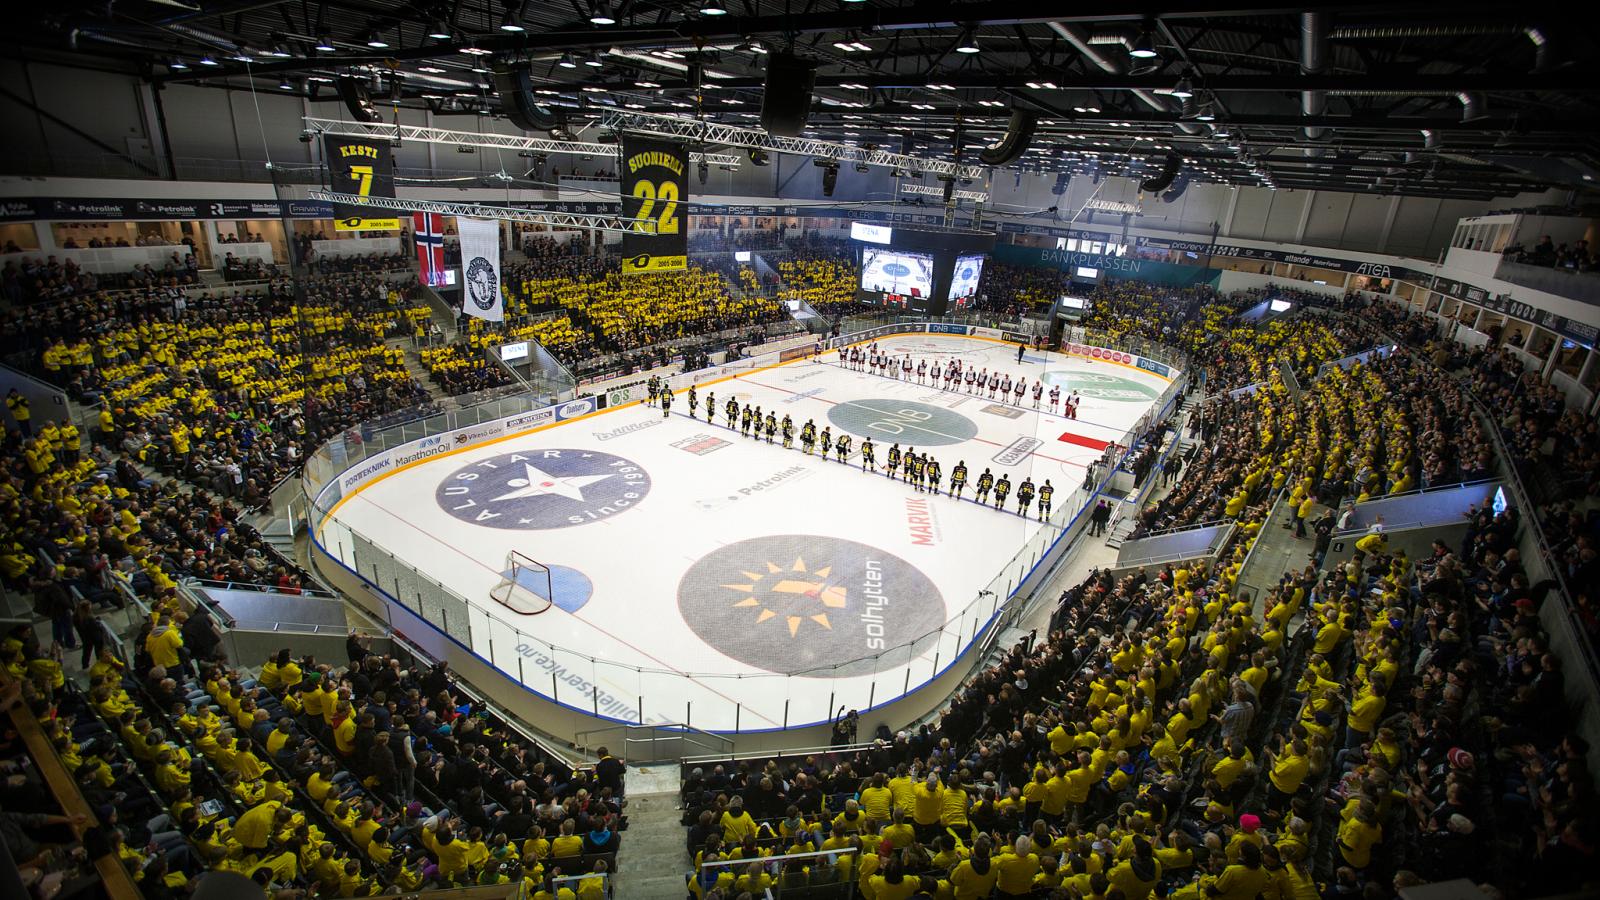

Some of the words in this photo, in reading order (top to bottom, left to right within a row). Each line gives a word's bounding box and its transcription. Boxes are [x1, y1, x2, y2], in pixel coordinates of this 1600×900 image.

[340, 145, 378, 159] KESTI
[628, 151, 684, 176] SUONIEMI
[350, 165, 373, 203] 7
[78, 204, 122, 213] Petrolink
[158, 204, 195, 213] Petrolink
[633, 179, 679, 234] 22
[1042, 250, 1141, 273] BANKPLASSEN
[1141, 359, 1155, 371] DNB
[867, 408, 933, 435] DNB
[445, 450, 561, 521] ALUSTAR
[610, 460, 645, 486] 1994
[737, 465, 806, 495] Petrolink
[568, 491, 639, 524] since
[905, 497, 935, 546] MARVIK
[861, 560, 889, 650] solhytten
[514, 643, 640, 721] billettservice.no
